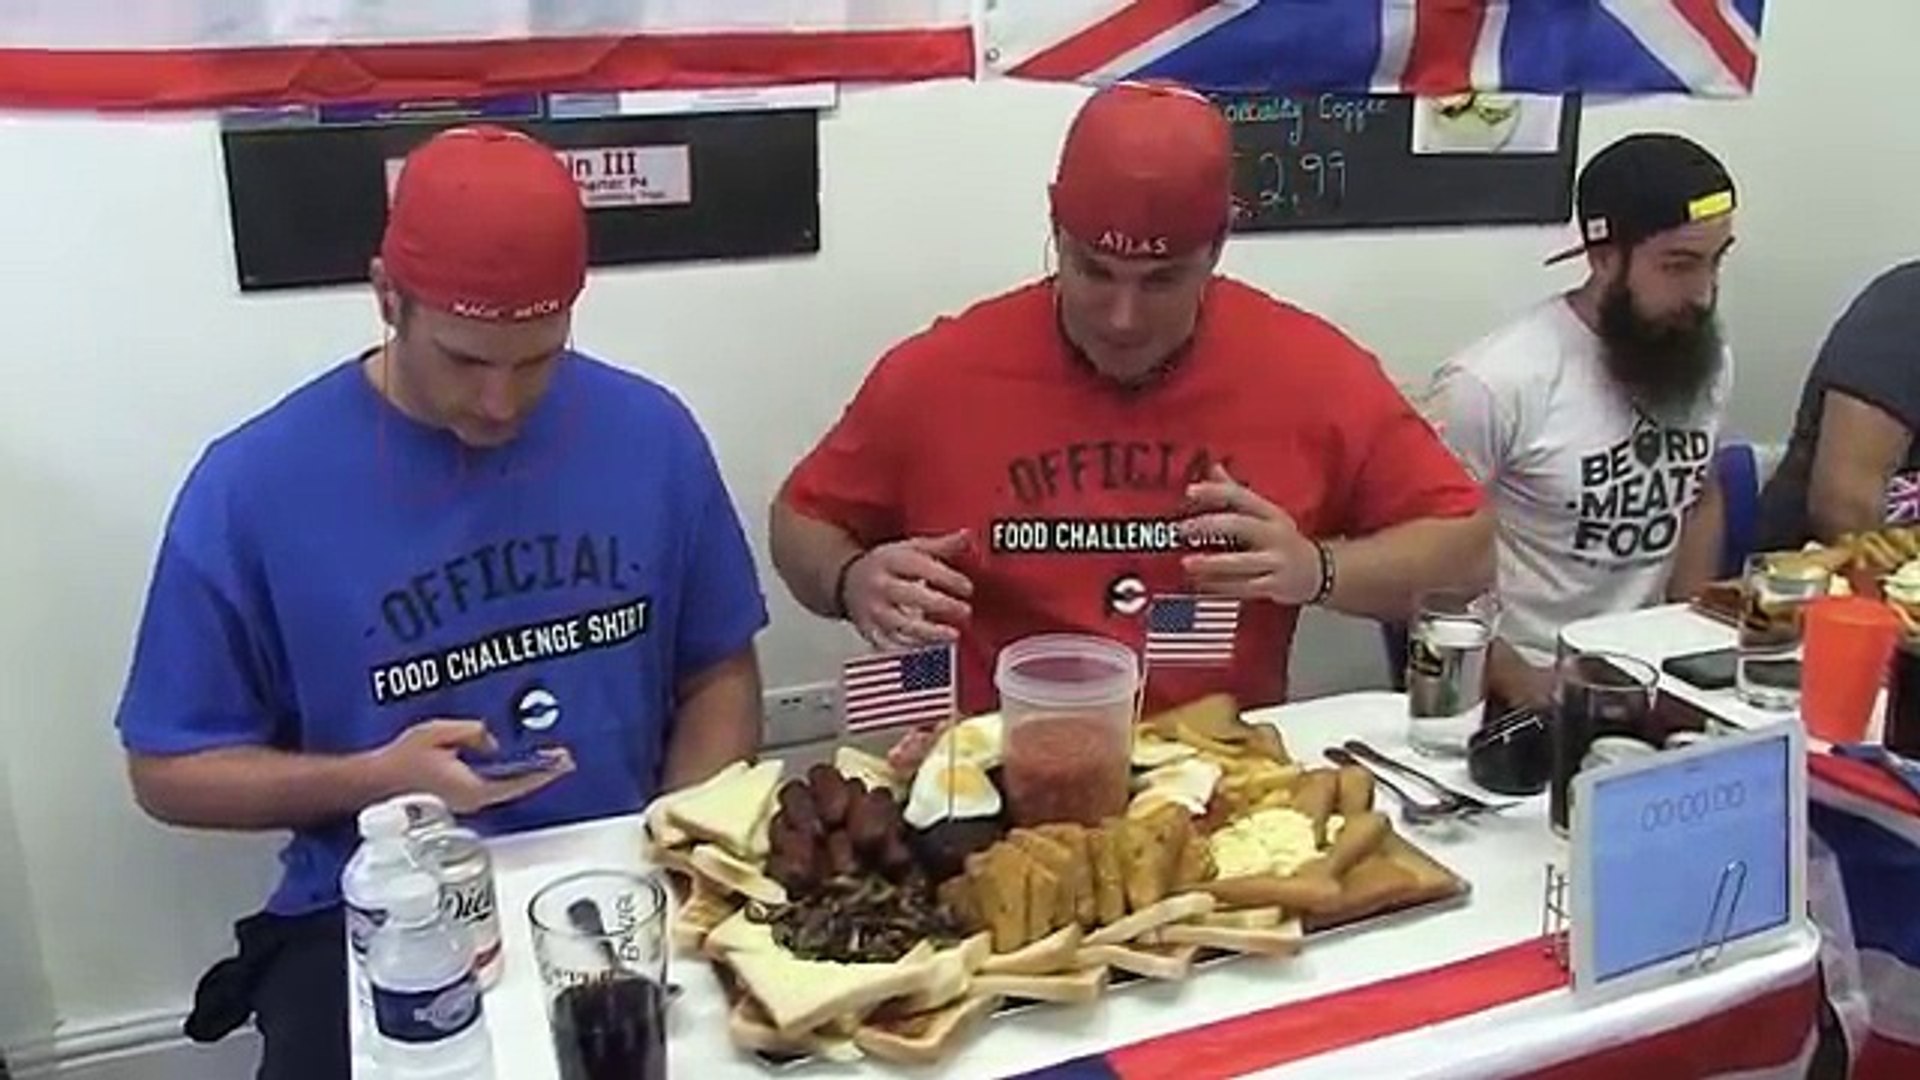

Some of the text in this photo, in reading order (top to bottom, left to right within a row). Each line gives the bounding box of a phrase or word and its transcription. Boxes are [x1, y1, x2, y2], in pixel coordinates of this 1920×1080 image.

[1099, 230, 1168, 256] ATLAS
[1008, 440, 1222, 505] OFFICIA
[993, 521, 1048, 549] FOOD
[1055, 521, 1181, 549] CHALLENGE
[1574, 512, 1679, 558] FOO
[381, 533, 627, 643] OFFICIAL
[372, 602, 648, 701] FOOD CHALLENGE SHIRT
